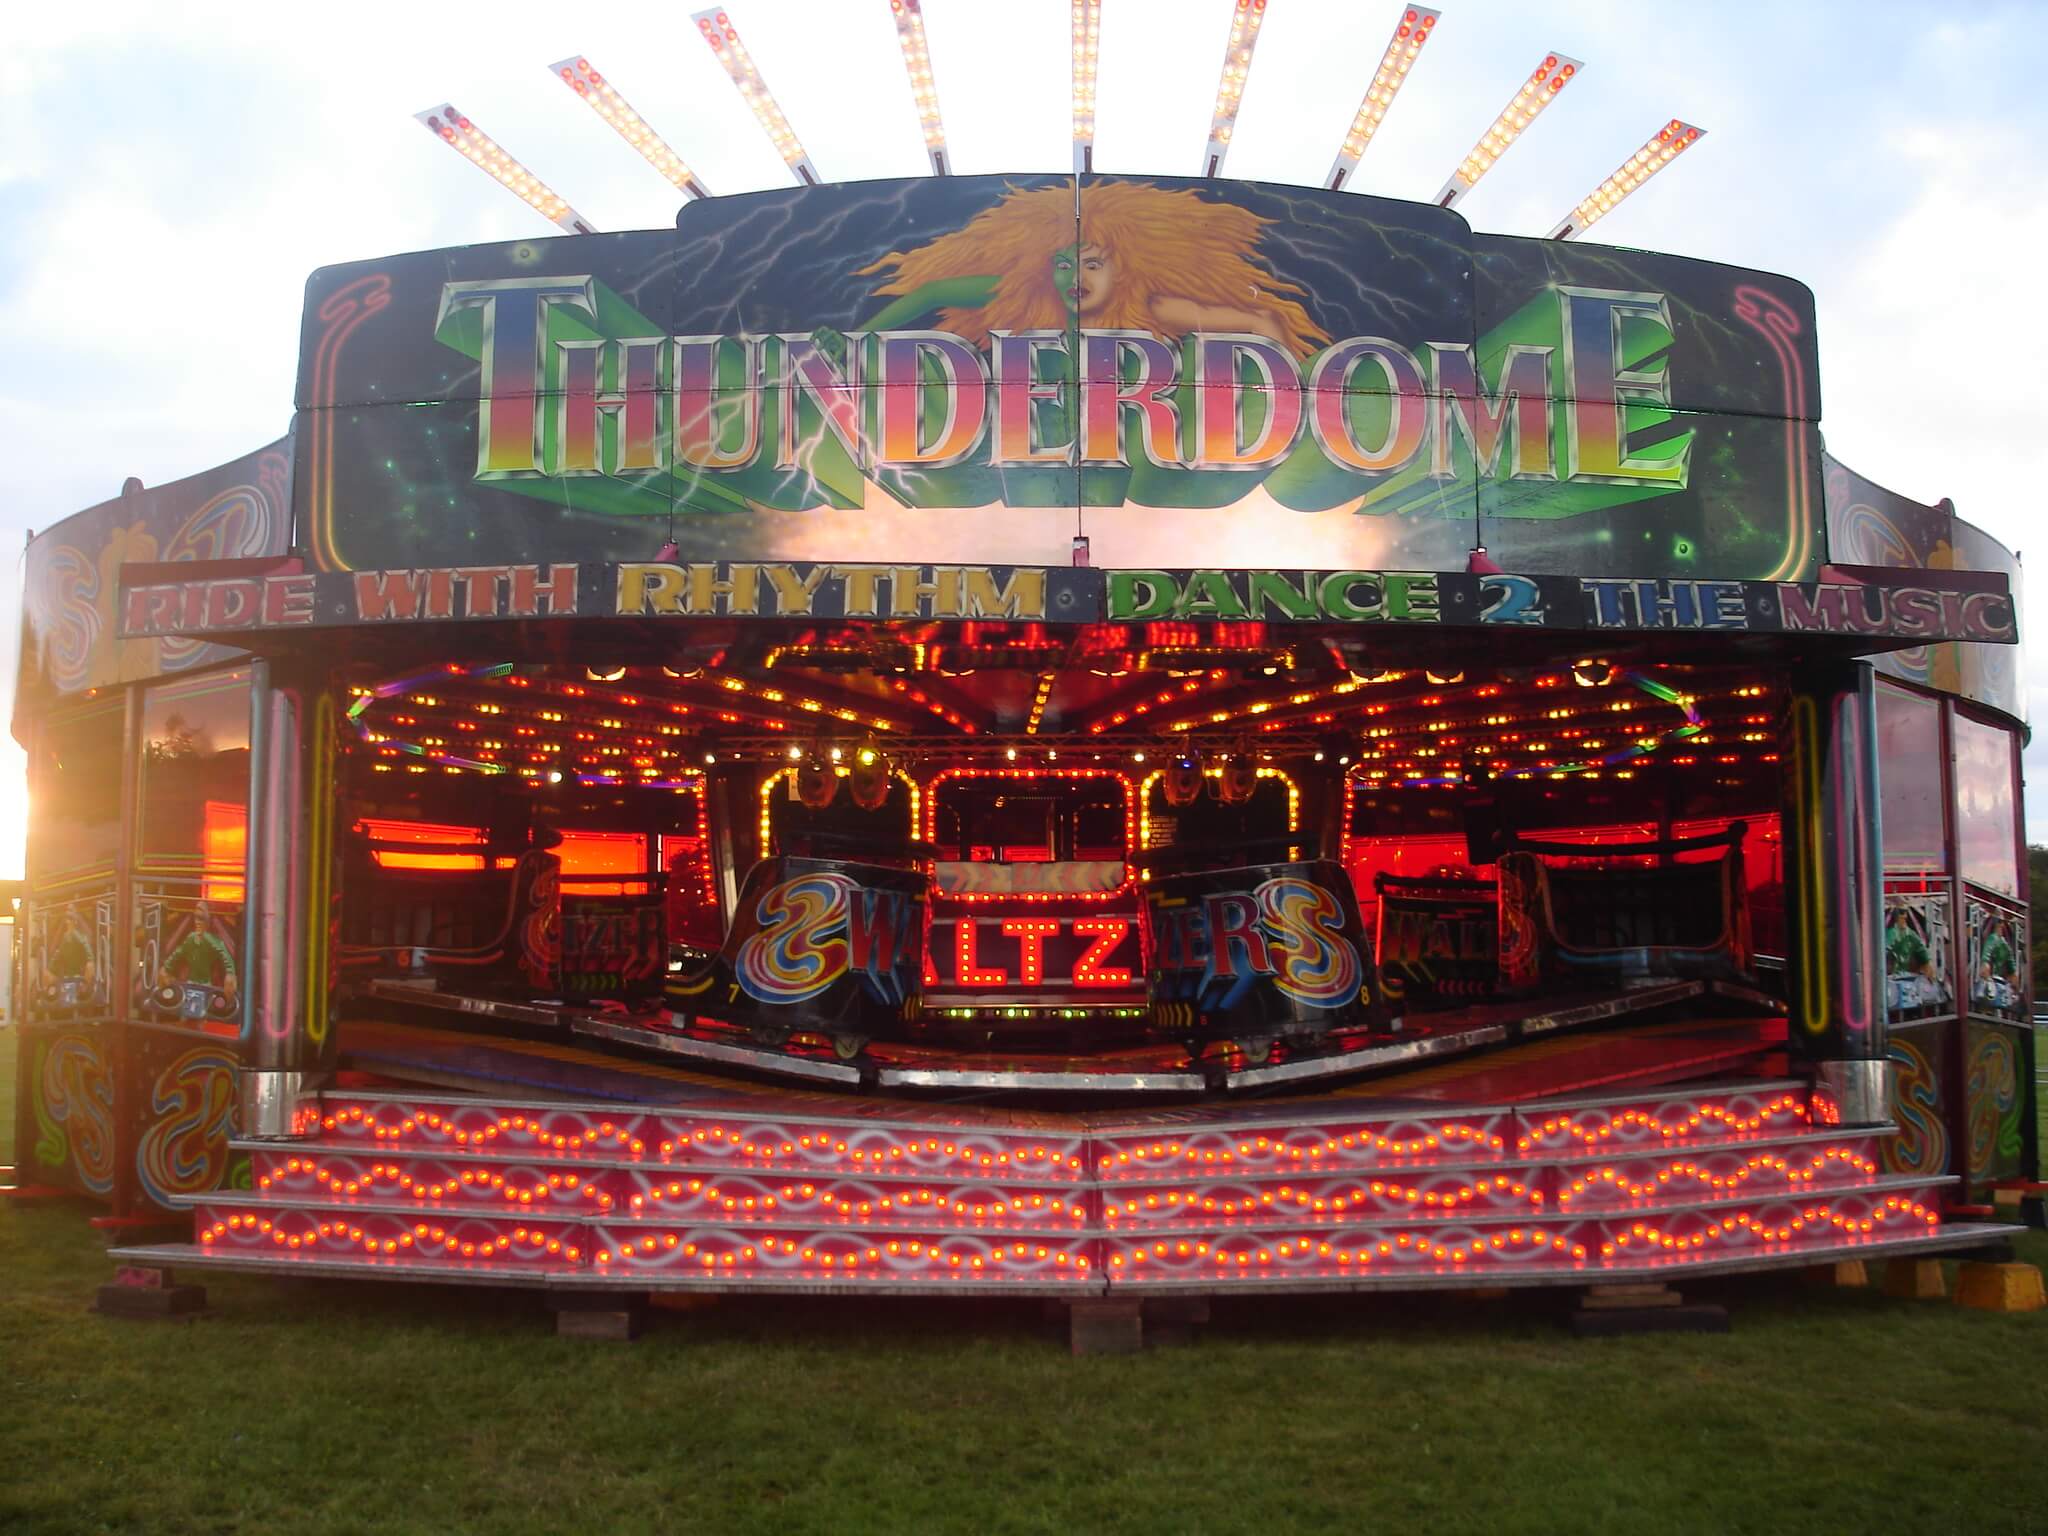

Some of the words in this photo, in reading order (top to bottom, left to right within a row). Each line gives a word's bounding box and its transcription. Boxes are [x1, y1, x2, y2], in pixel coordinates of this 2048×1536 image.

[437, 276, 1690, 490] THUNDERDOME
[123, 573, 317, 635] RIDE
[352, 562, 579, 620] WITH
[615, 563, 1047, 619] RHYTHM
[1106, 570, 1441, 623] DANCE
[1478, 574, 1544, 626] 2
[1580, 577, 1749, 630] THE
[1776, 583, 2012, 637] MUSIC
[922, 918, 1132, 987] LTZ
[728, 984, 742, 1004] 7
[1359, 985, 1371, 1007] 8
